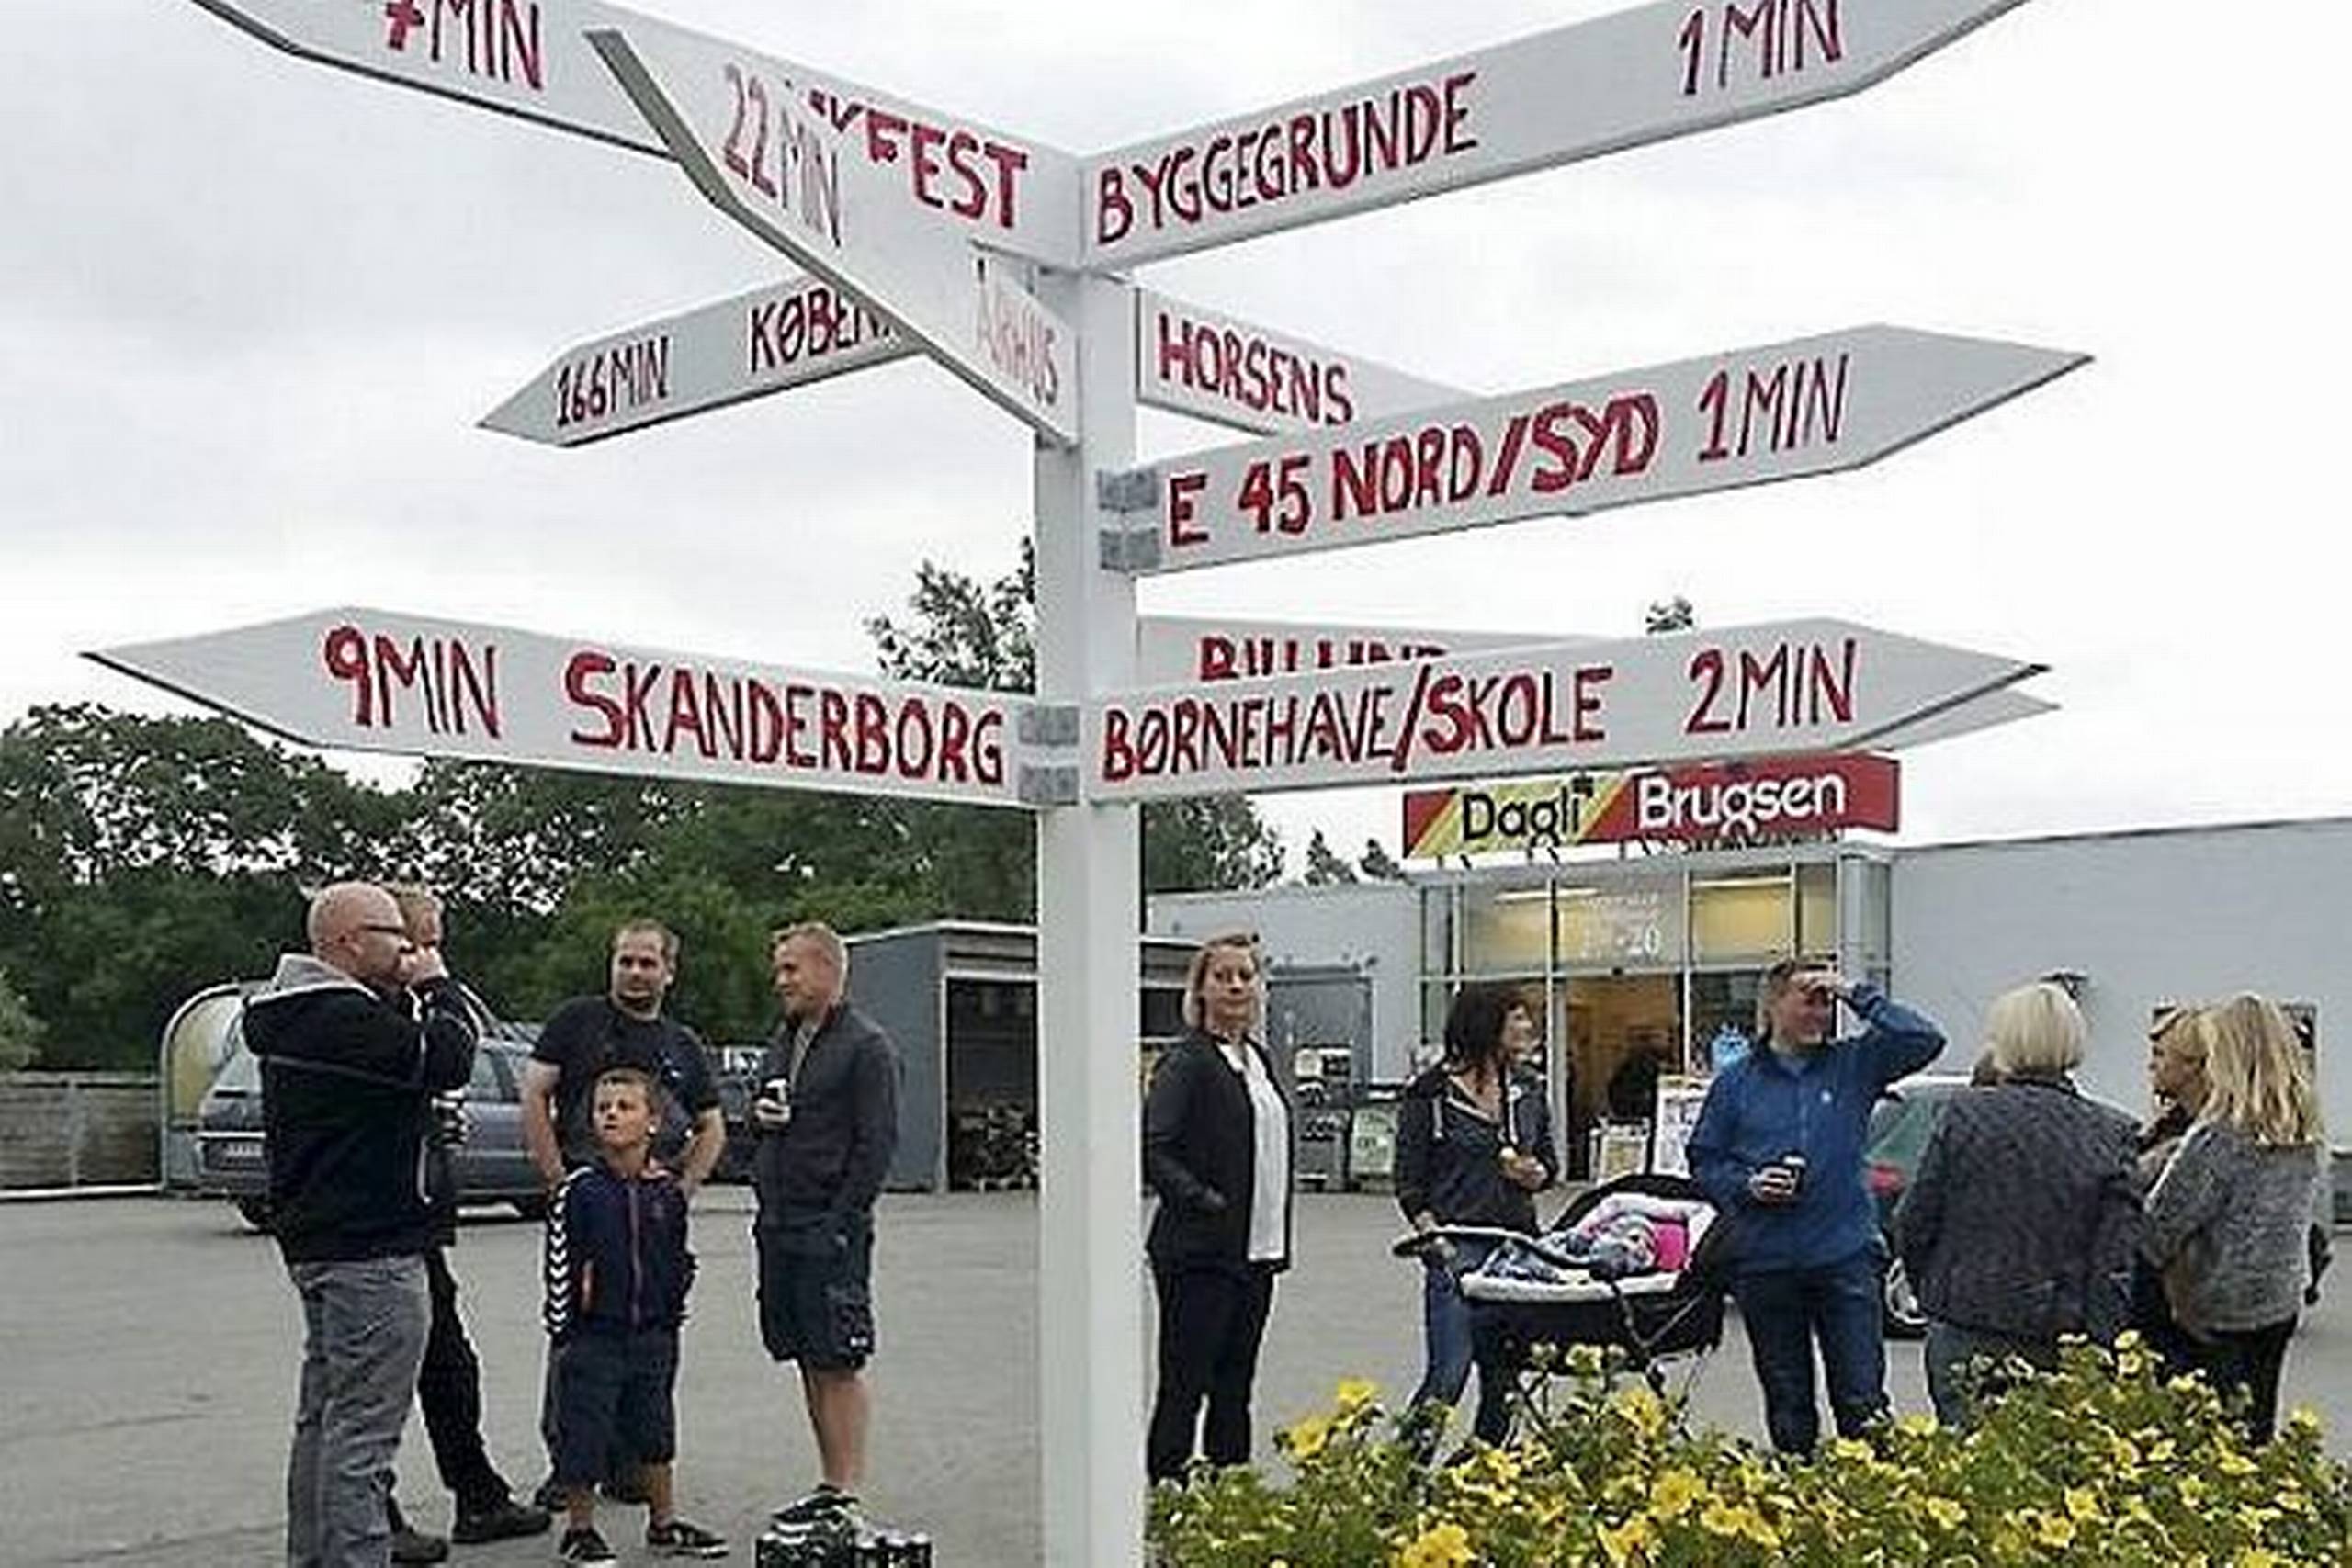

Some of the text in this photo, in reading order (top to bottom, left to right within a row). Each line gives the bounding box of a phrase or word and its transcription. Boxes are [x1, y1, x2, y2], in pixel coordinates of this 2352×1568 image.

[1099, 73, 1478, 245] BYGGEGRUNDE
[1159, 313, 1352, 425] HORSENS
[1170, 473, 1209, 547] E
[1238, 455, 1311, 535] 45
[1333, 393, 1659, 521] NORD/SYD
[564, 652, 1005, 786] SKANDERBORG
[1102, 665, 1614, 783] BØRNEHAVE/SKOLE
[1463, 773, 1846, 847] Dagli Brugsen
